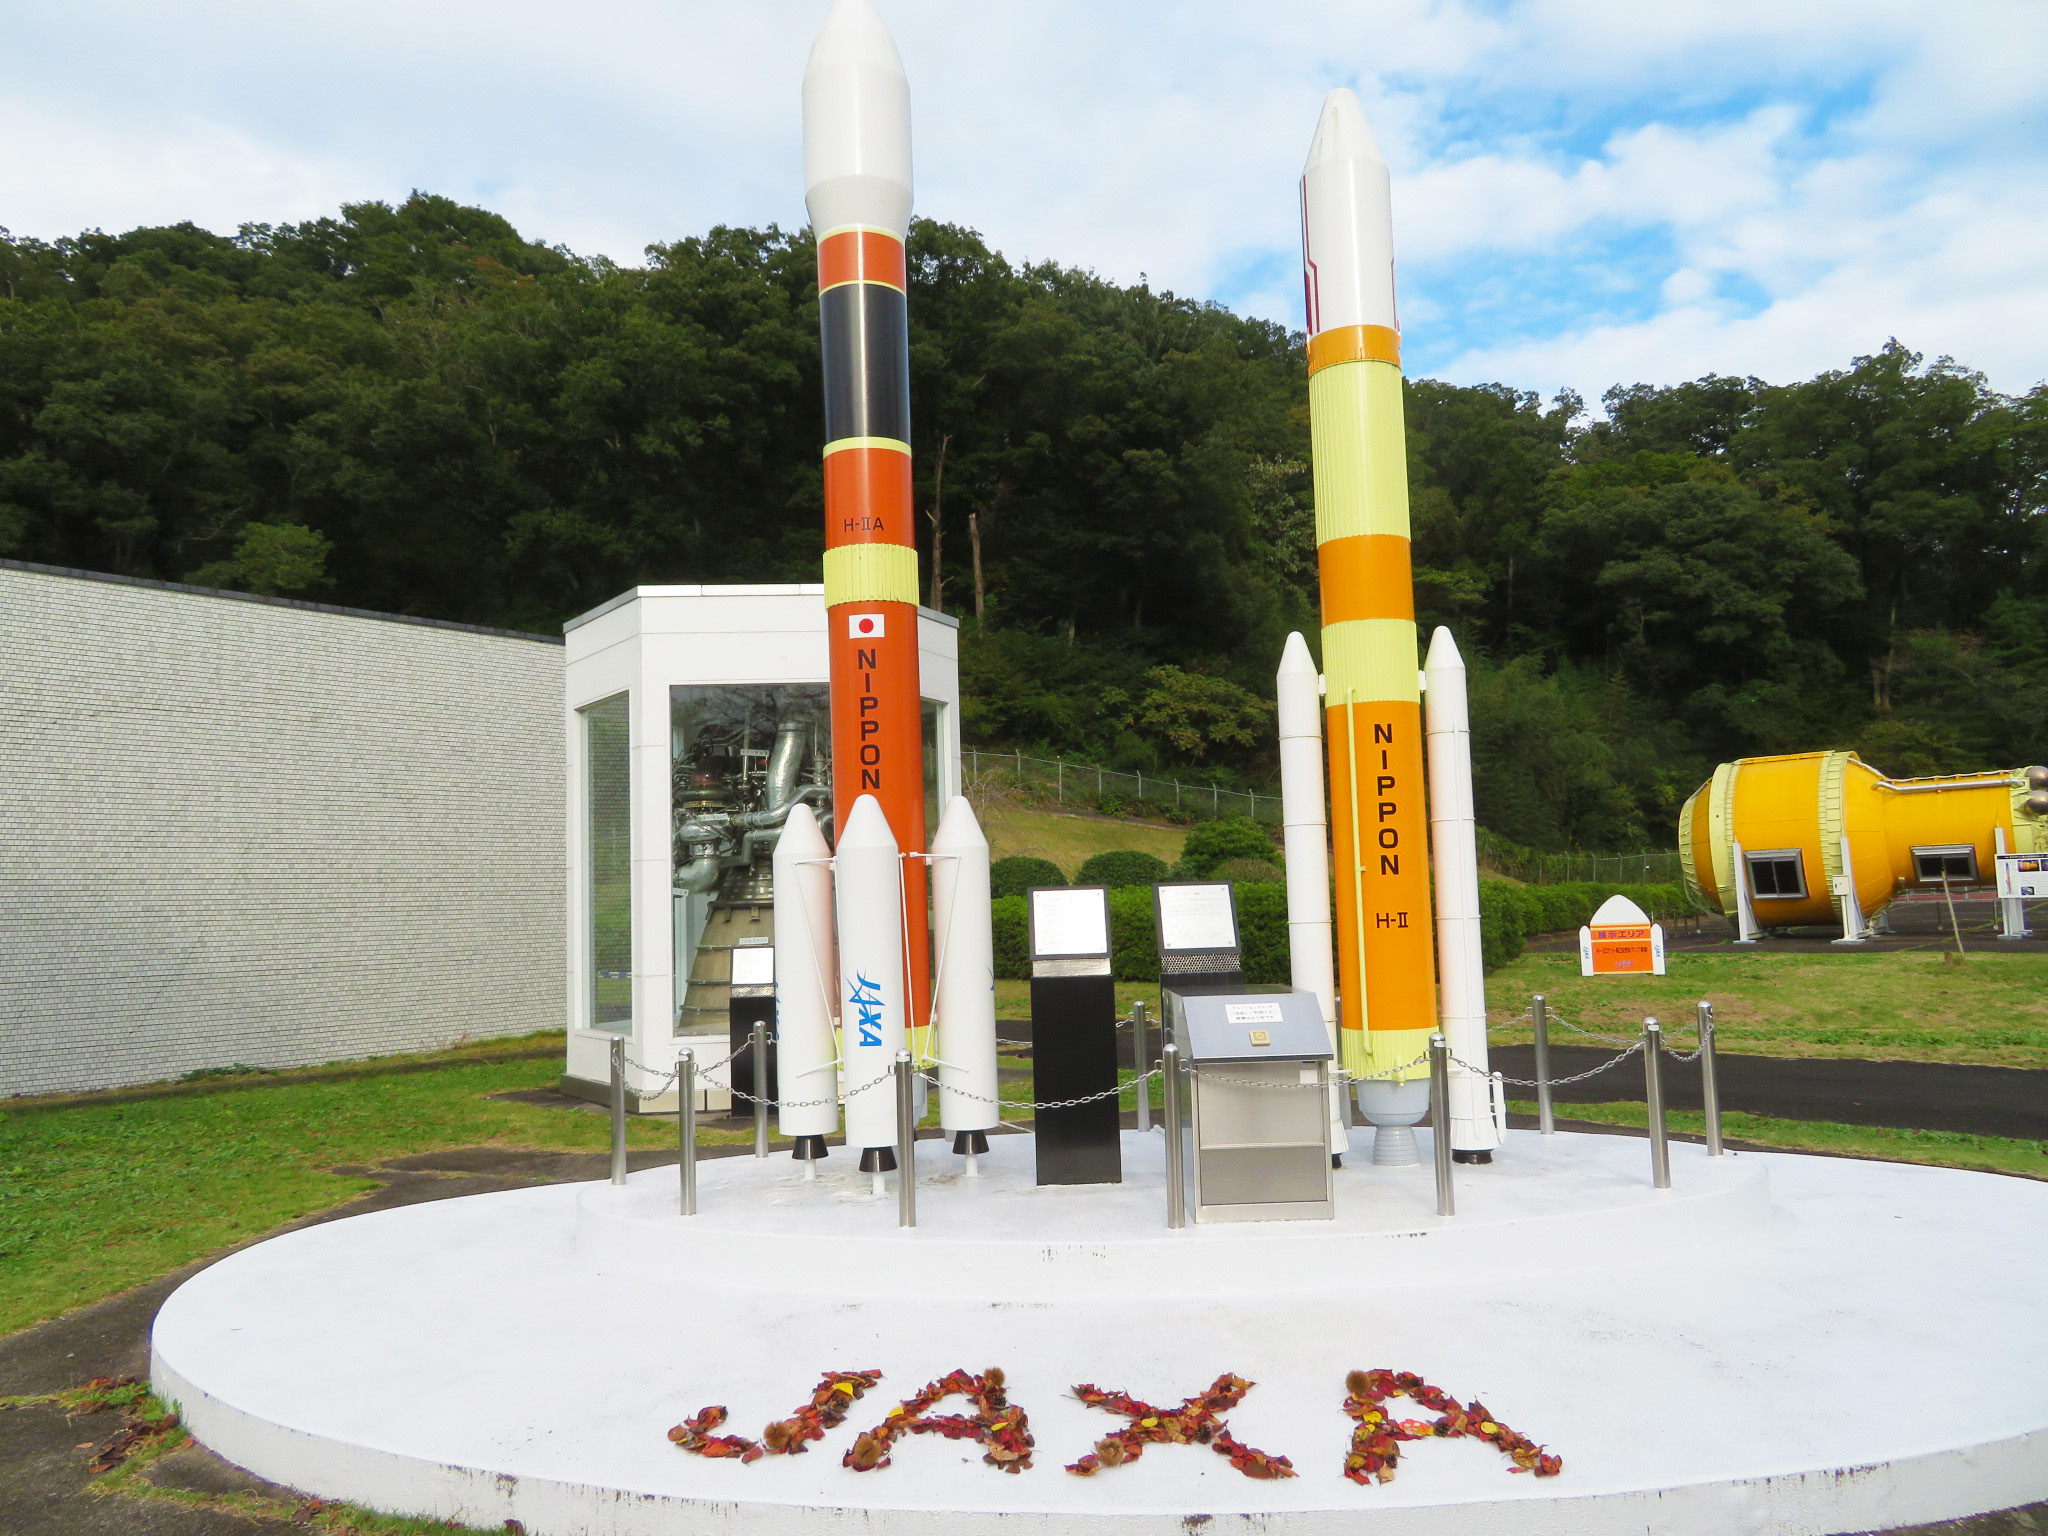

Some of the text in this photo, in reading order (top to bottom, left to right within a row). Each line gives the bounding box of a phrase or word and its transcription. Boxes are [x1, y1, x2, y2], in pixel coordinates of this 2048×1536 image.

[857, 648, 881, 790] NIPPON
[1373, 723, 1400, 876] NIPPON
[845, 965, 887, 1047] JAXA
[668, 1368, 1563, 1486] JAXA
